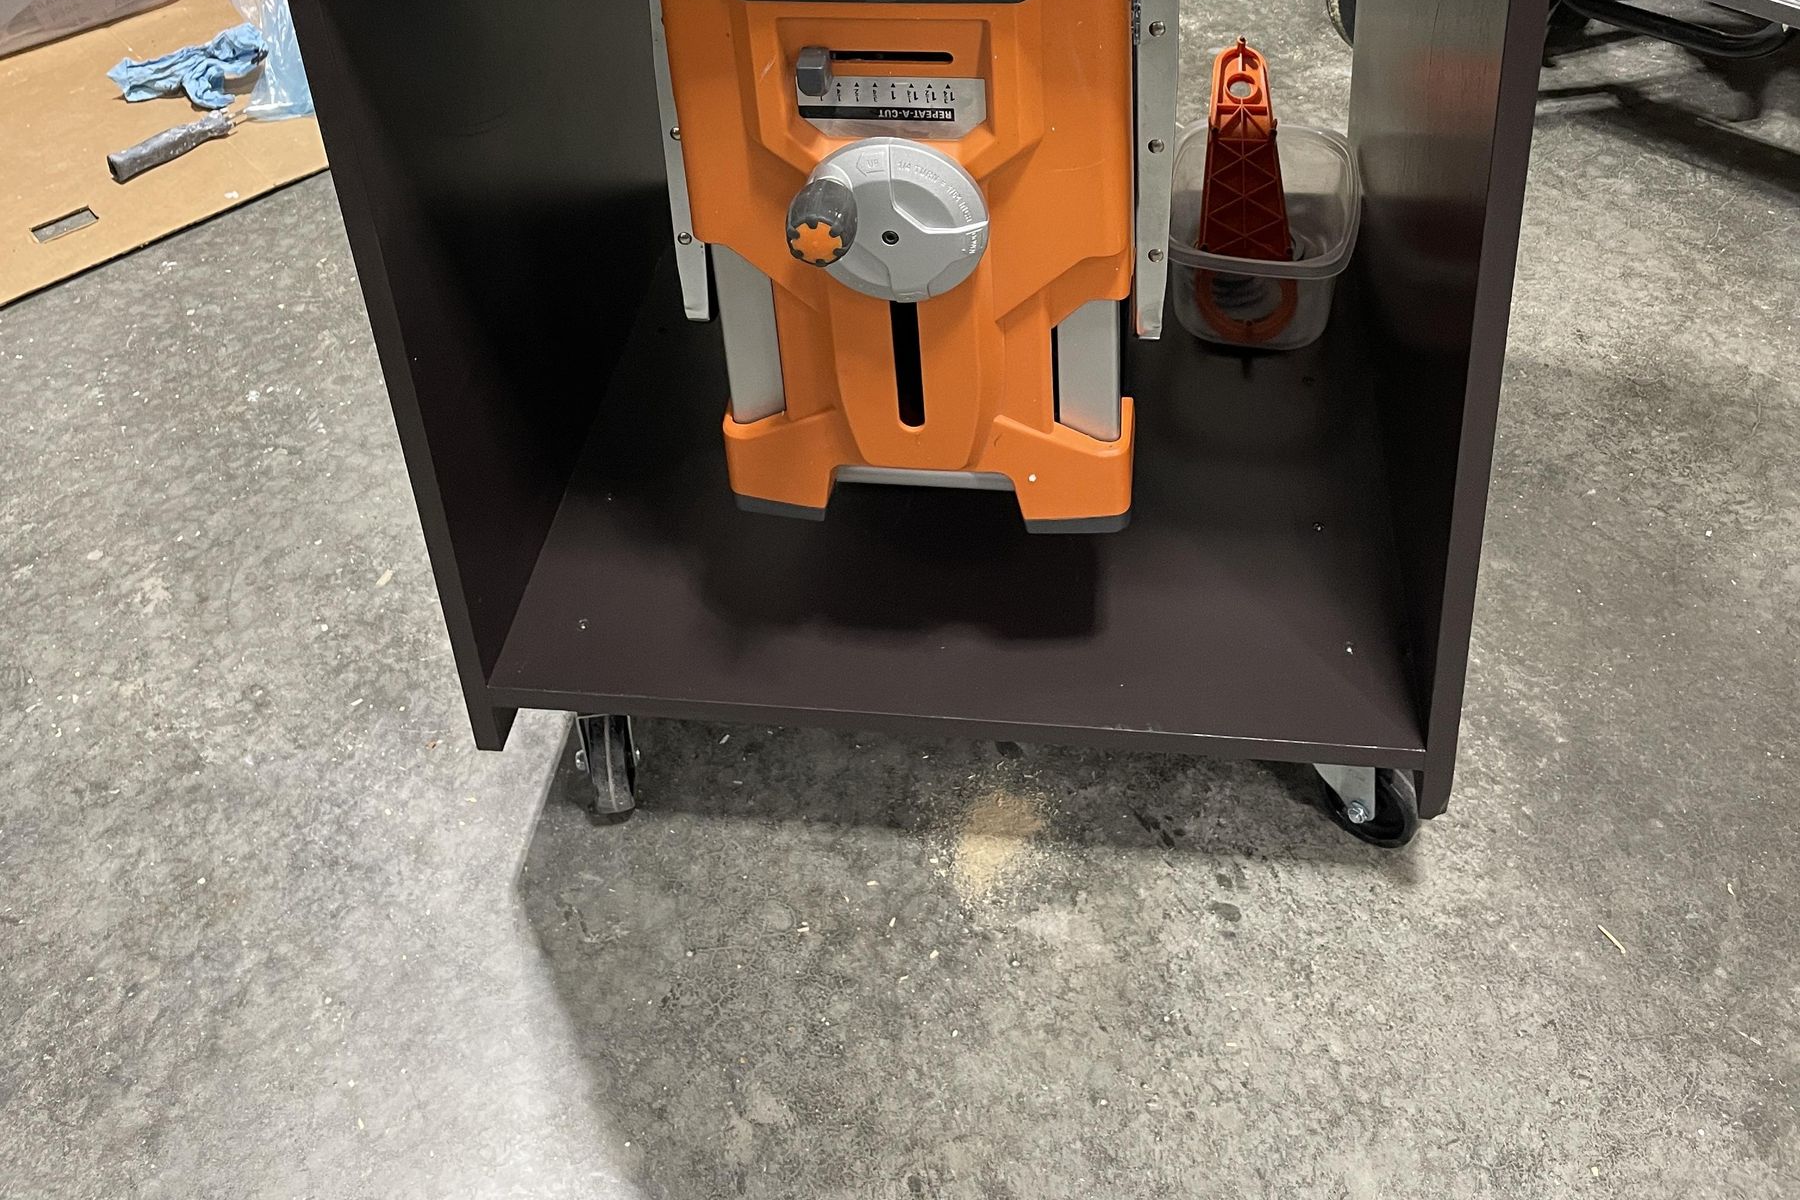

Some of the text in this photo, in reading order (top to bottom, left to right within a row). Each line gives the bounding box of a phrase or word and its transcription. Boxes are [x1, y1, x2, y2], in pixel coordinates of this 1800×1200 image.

[892, 91, 896, 100] 1
[878, 109, 952, 119] REPEAT-A-CUT
[867, 159, 879, 168] UP
[914, 164, 940, 183] TURN
